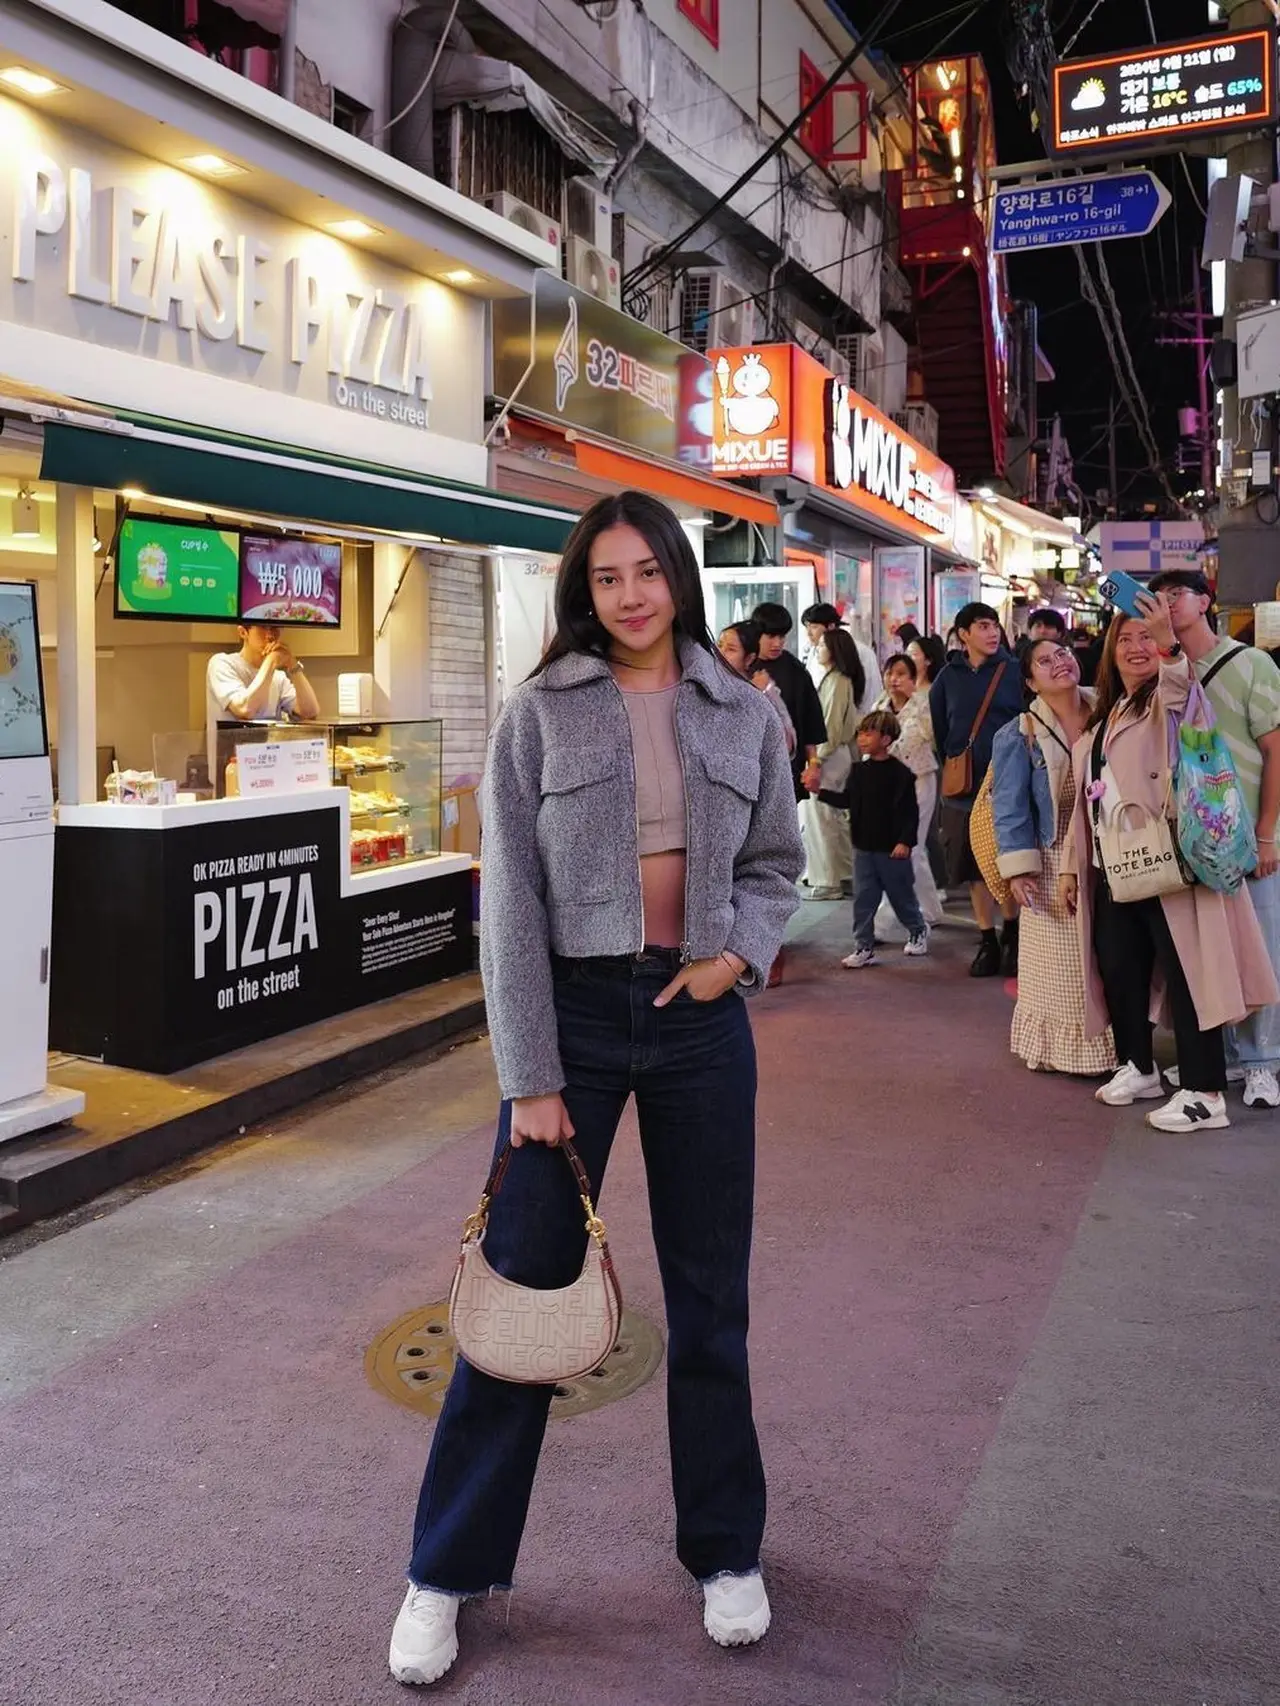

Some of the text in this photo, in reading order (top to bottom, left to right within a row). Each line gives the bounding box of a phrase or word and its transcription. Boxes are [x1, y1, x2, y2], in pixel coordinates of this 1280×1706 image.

[1162, 54, 1181, 70] 4월
[1184, 50, 1211, 67] 21일
[1120, 77, 1148, 96] 대기
[1120, 96, 1149, 115] 기온
[1194, 83, 1225, 103] 습도
[1227, 78, 1262, 97] 65%
[1000, 184, 1094, 215] 양화로16길
[1000, 204, 1122, 231] Yanghwa-ro 16-gil
[12, 155, 433, 401] PLEASE PIZZA
[337, 382, 430, 429] On the street
[712, 438, 788, 464] MIXUE
[854, 407, 916, 516] MIXUE
[258, 561, 322, 599] ₩5,000
[193, 844, 319, 882] OK PIZZA READY IN 4MINUTES
[1123, 846, 1149, 860] THE
[1144, 852, 1172, 867] BAG
[194, 872, 319, 980] PIZZA
[217, 964, 300, 1010] on the street
[466, 1309, 601, 1349] CELINE
